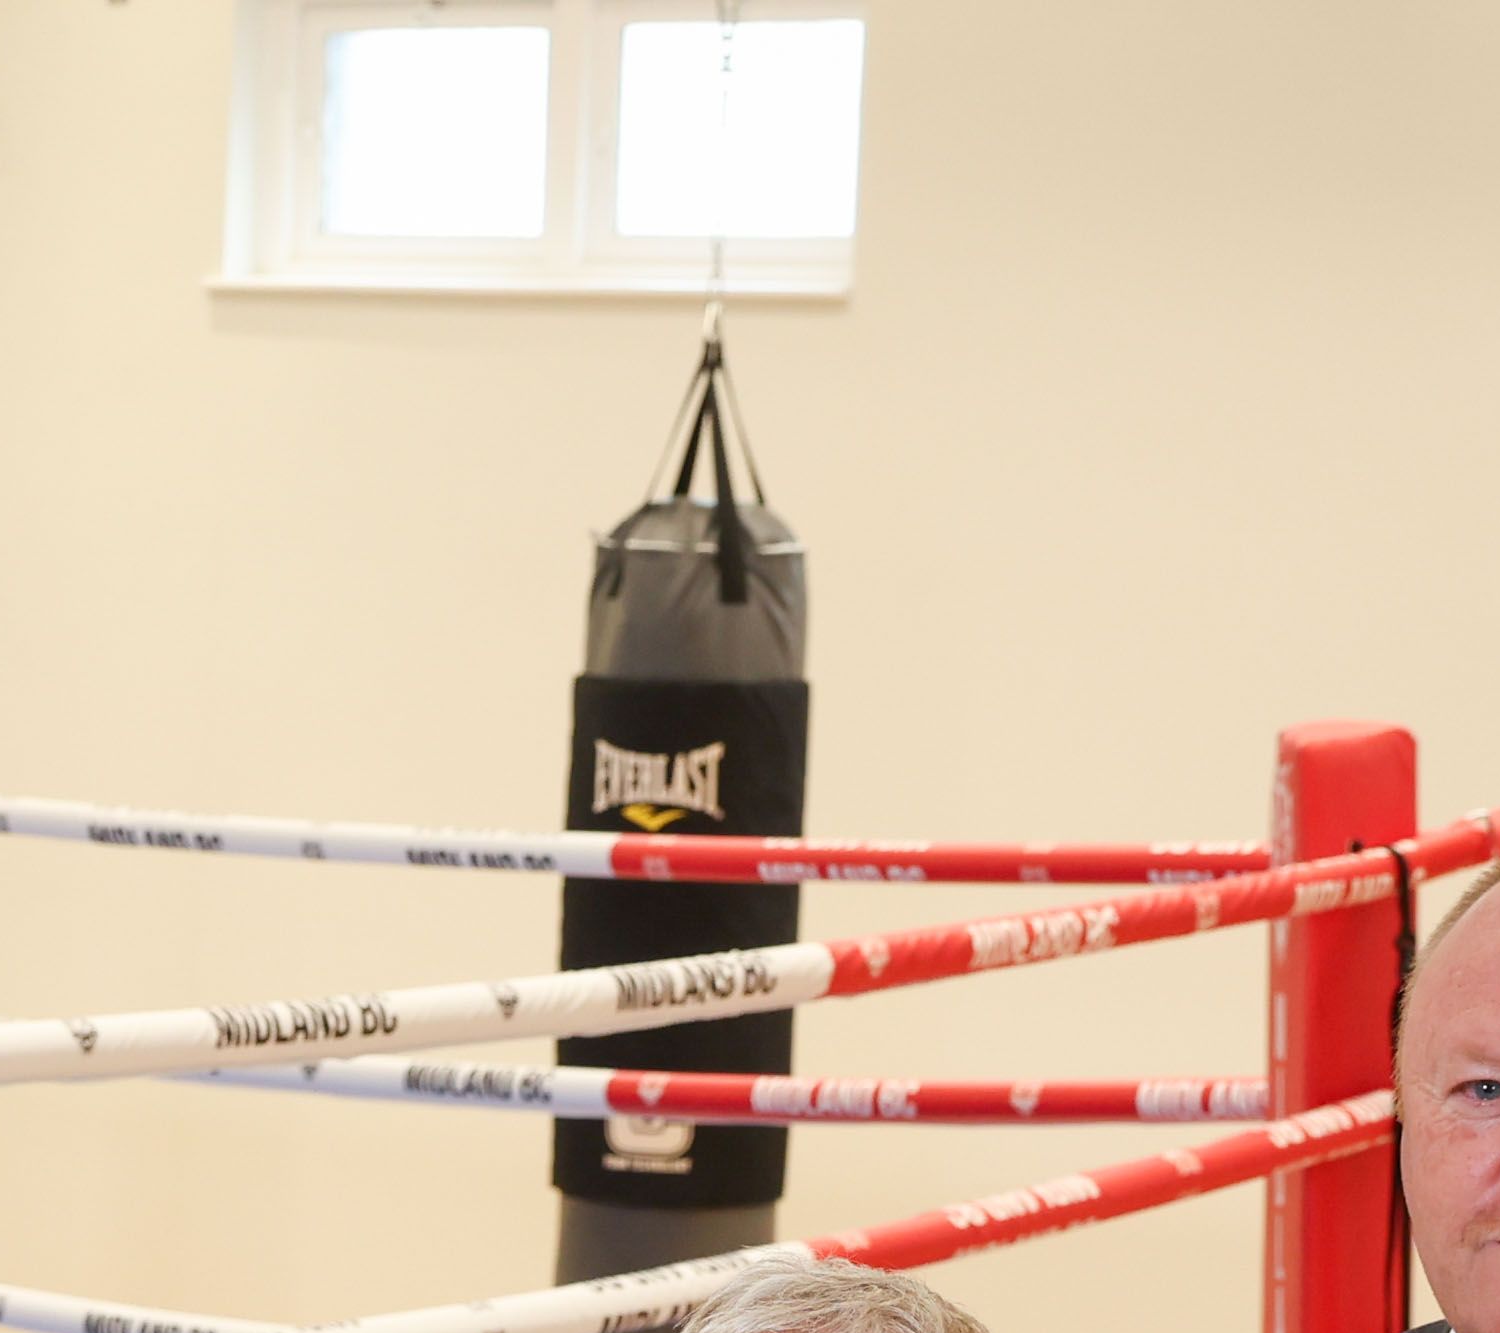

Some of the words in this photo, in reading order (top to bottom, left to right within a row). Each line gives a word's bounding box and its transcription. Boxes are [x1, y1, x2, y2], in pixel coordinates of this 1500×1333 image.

[592, 738, 725, 820] EVERLAST
[741, 953, 778, 997] BC
[212, 1000, 353, 1049] MIDLAND
[360, 997, 399, 1037] BC
